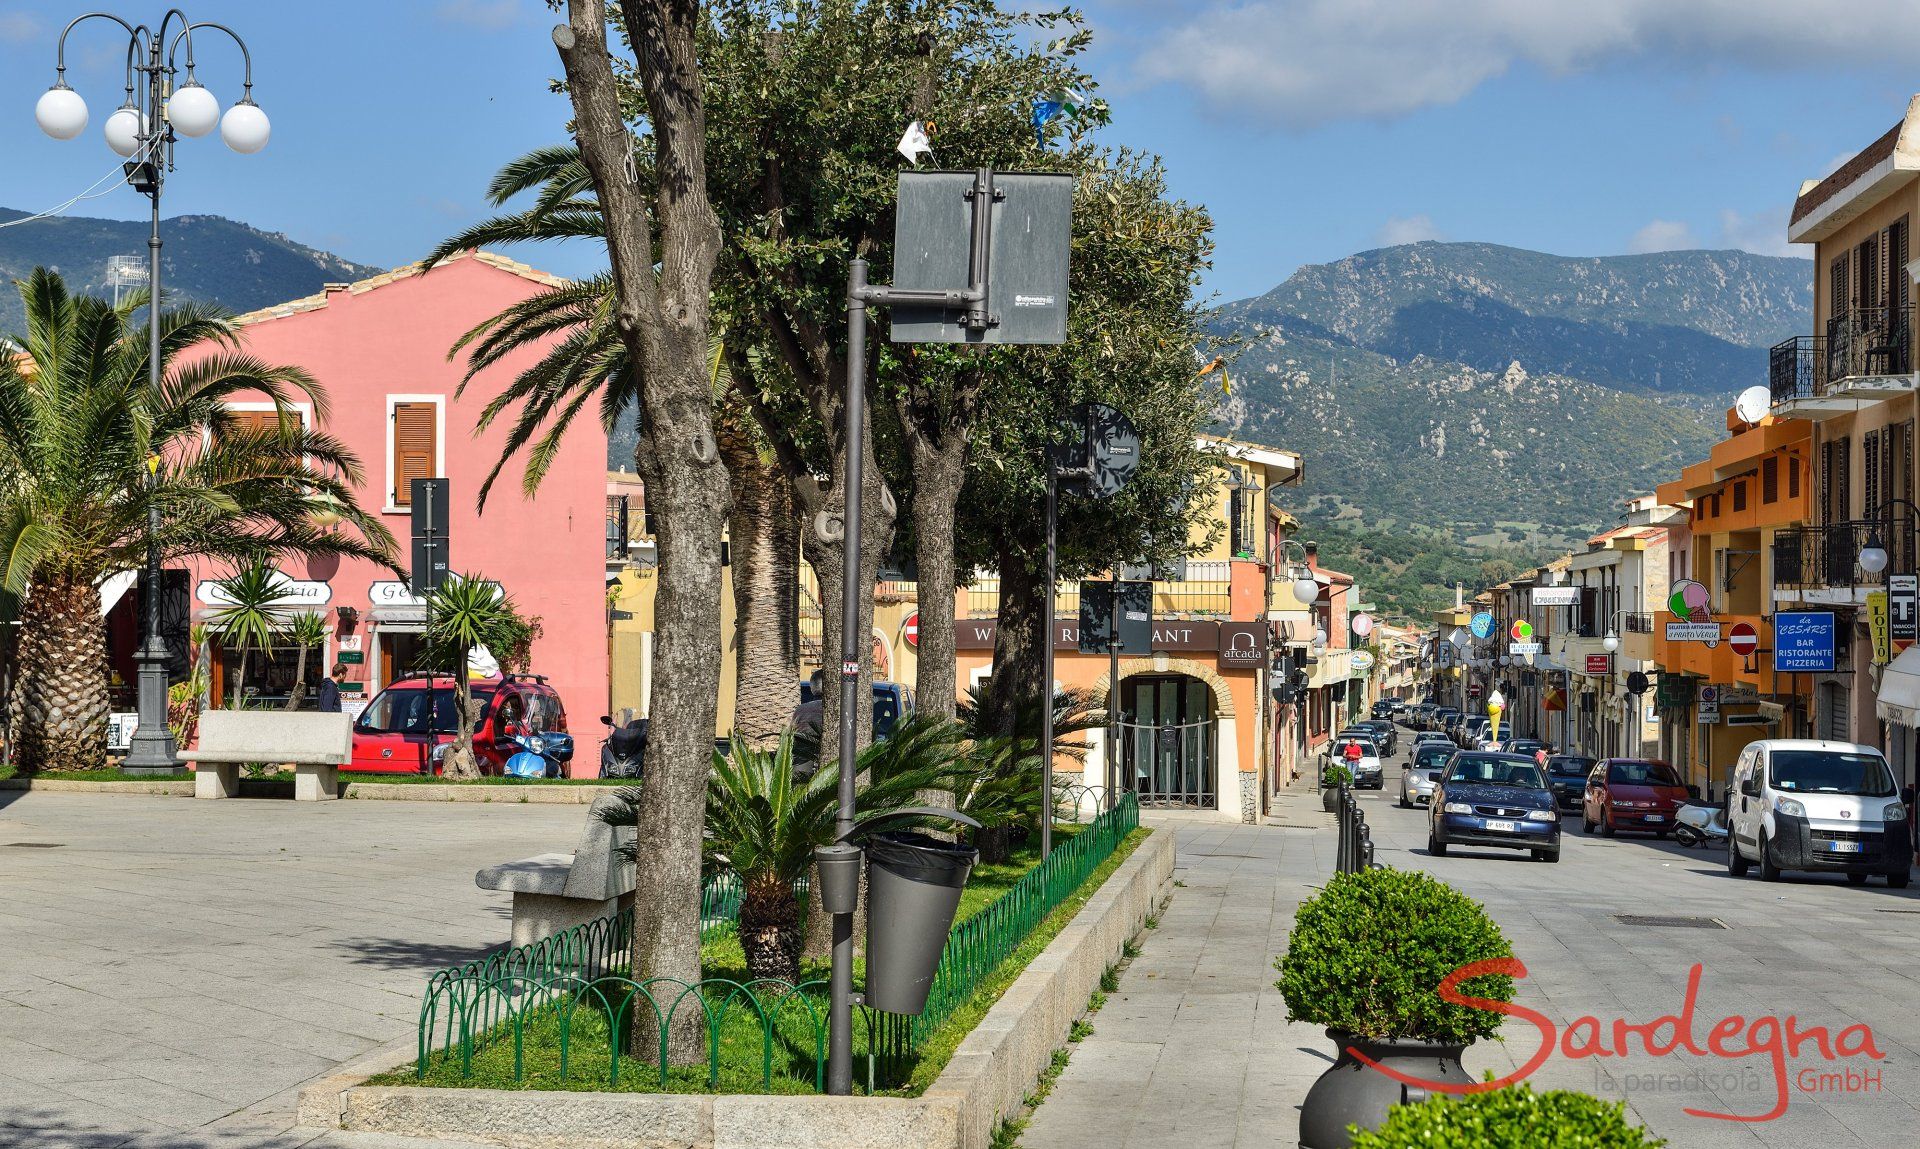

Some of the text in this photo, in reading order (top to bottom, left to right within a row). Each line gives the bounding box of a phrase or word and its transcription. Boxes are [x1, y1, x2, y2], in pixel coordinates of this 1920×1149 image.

[1799, 616, 1811, 624] da
[1695, 630, 1718, 638] VERDE
[1873, 606, 1886, 658] LOTTO
[1796, 639, 1814, 647] BAR
[1224, 648, 1262, 659] arcada
[1778, 649, 1832, 657] RISTORANTE
[1786, 659, 1825, 667] PIZZERIA
